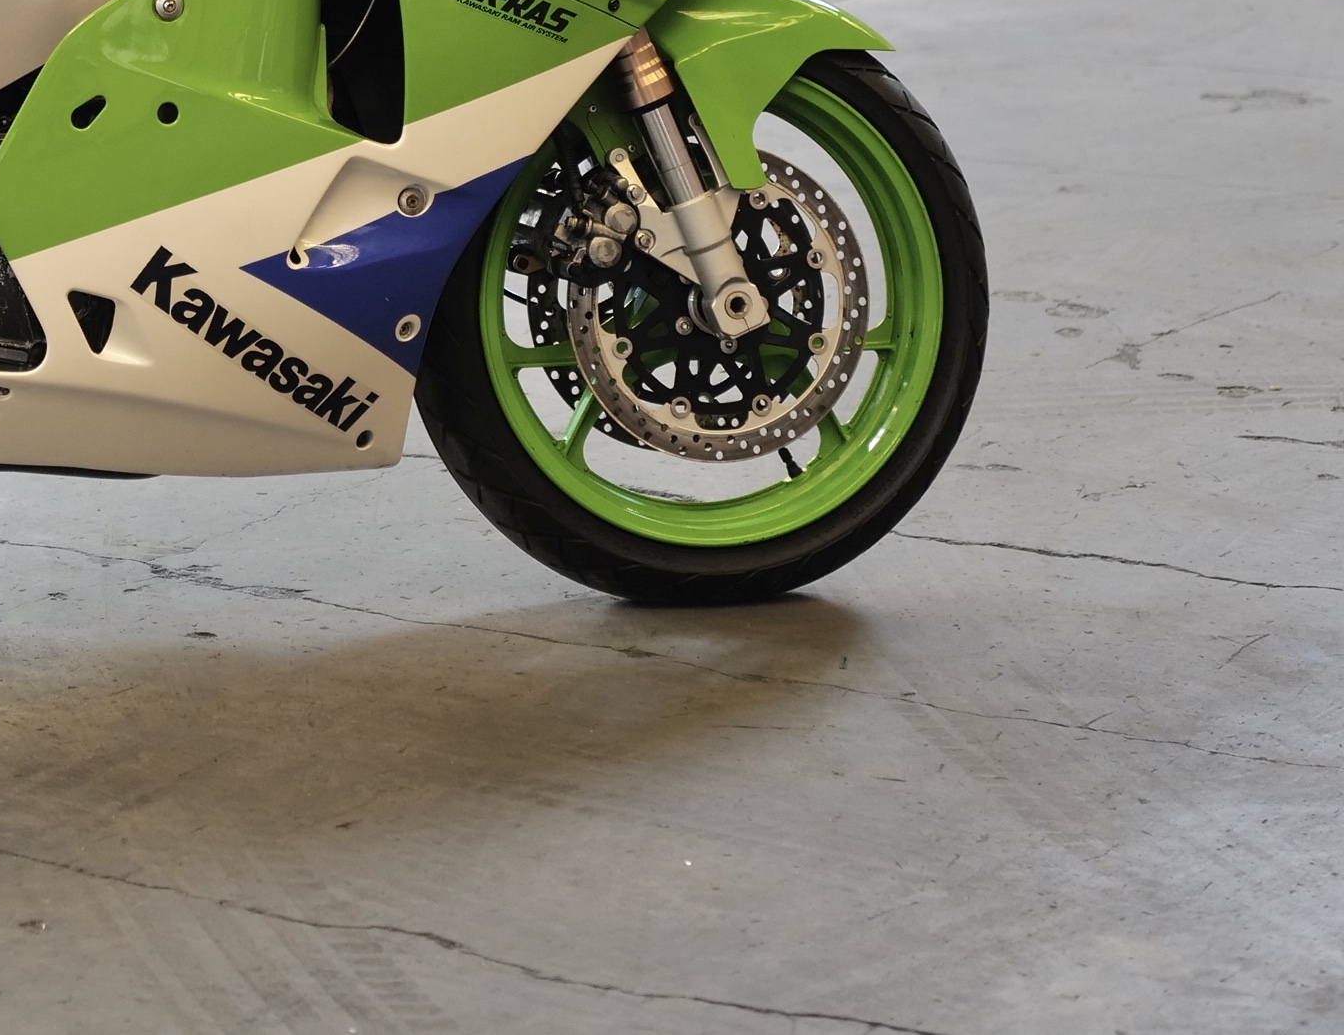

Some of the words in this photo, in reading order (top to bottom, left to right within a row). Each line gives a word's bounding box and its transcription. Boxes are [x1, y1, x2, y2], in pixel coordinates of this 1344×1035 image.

[501, 14, 522, 26] RAM
[521, 21, 537, 32] AIR
[536, 27, 568, 44] SYSTEM
[130, 245, 379, 433] Kawasaki
